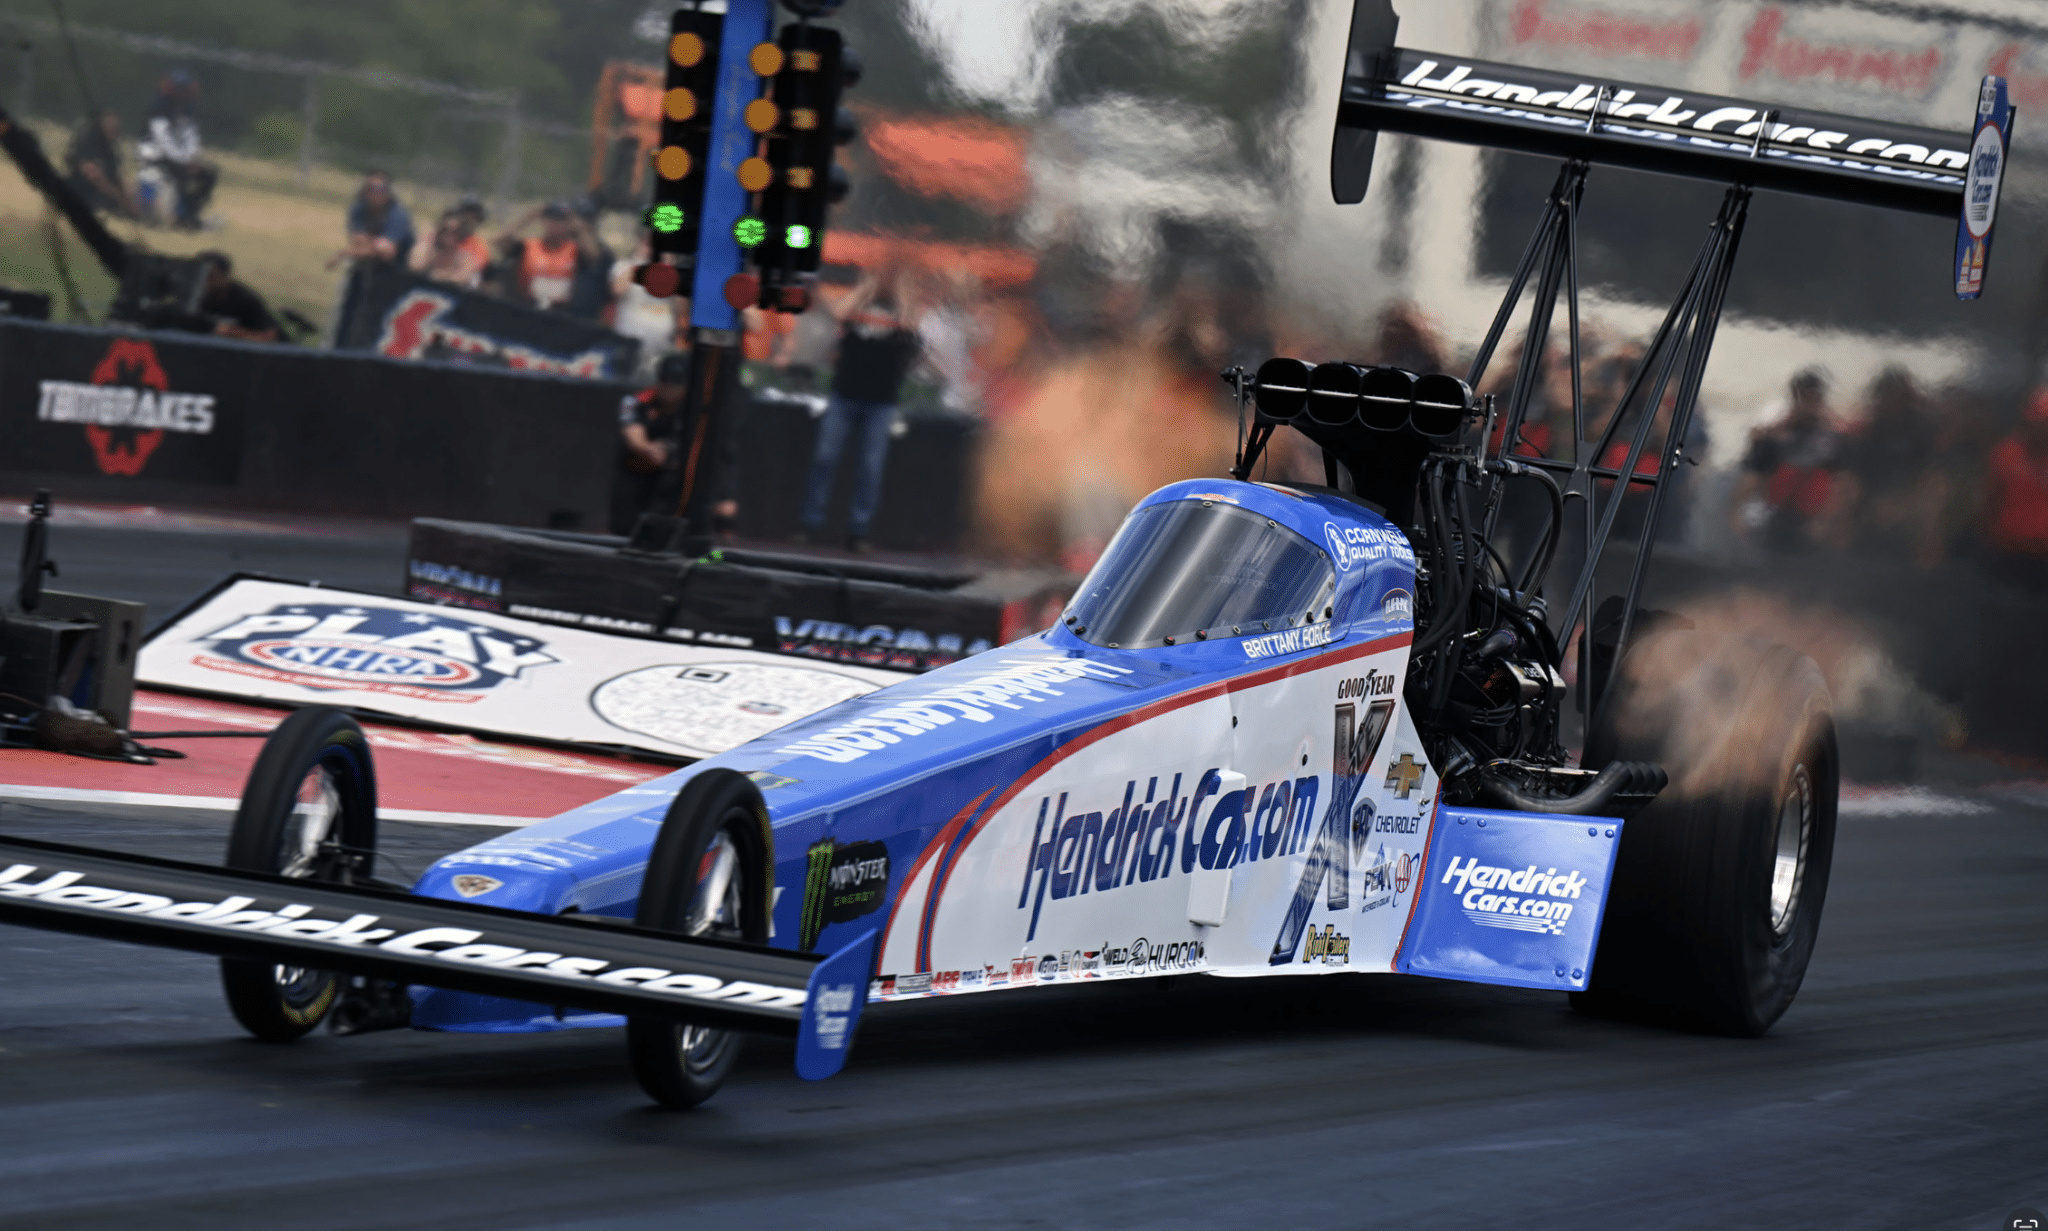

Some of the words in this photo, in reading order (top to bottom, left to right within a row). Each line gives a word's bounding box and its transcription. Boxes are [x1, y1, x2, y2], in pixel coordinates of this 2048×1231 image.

[1350, 545, 1388, 561] QUALITY
[1389, 546, 1413, 560] TOOLS
[204, 611, 562, 678] PLAY
[1240, 629, 1301, 659] BRITTANY
[1302, 622, 1332, 648] FORCE
[284, 645, 442, 677] NHRA
[1375, 815, 1421, 834] CHEVROLET
[828, 857, 887, 890] MONSTER
[1363, 861, 1393, 899] PEAK
[1441, 855, 1588, 899] Hendrick
[1462, 888, 1574, 920] Cars.com
[0, 863, 809, 1007] HendrickCars.com
